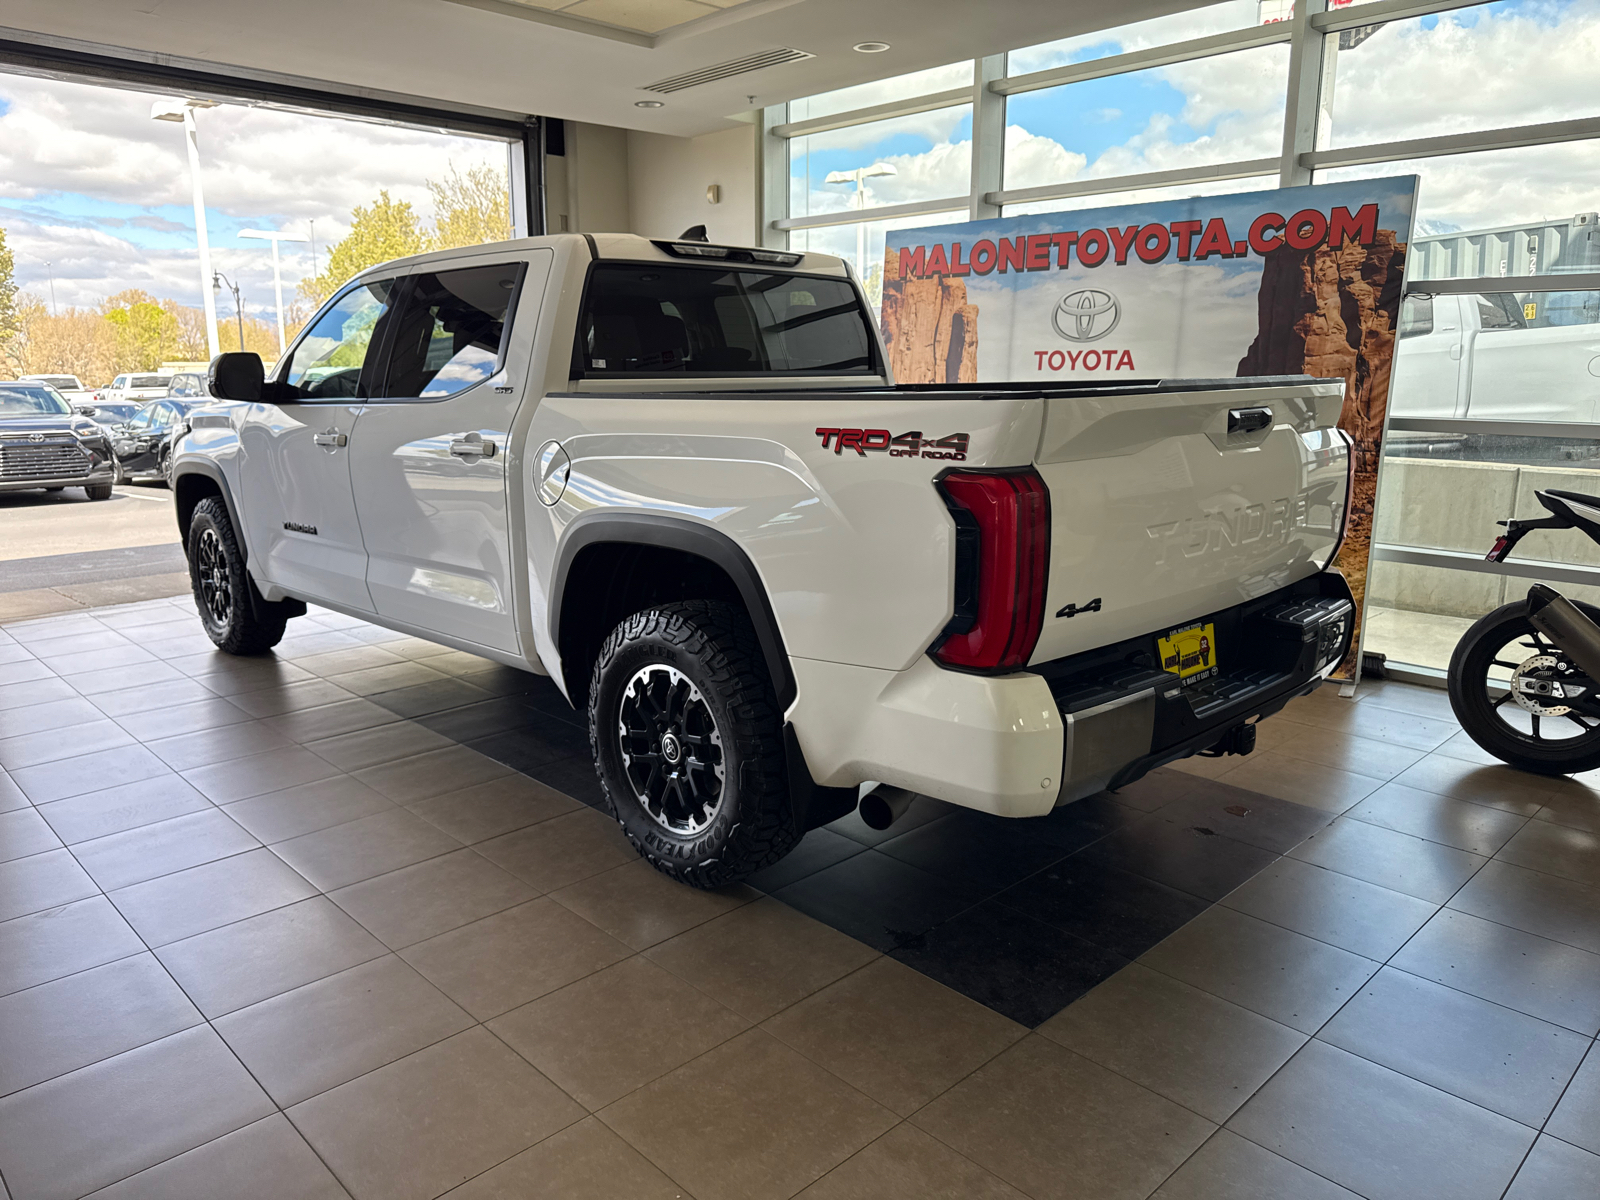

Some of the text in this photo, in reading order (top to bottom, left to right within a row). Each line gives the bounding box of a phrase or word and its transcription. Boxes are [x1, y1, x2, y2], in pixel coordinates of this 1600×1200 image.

[899, 203, 1380, 278] MALONETOYOTA.COM
[1034, 349, 1135, 371] TOYOTA
[815, 427, 970, 457] TRD 4x4
[889, 448, 967, 461] OFF ROAD
[1201, 639, 1207, 648] 32
[1186, 675, 1197, 685] MAKE
[1201, 671, 1210, 680] EASY
[644, 814, 729, 861] GOODYEAR
